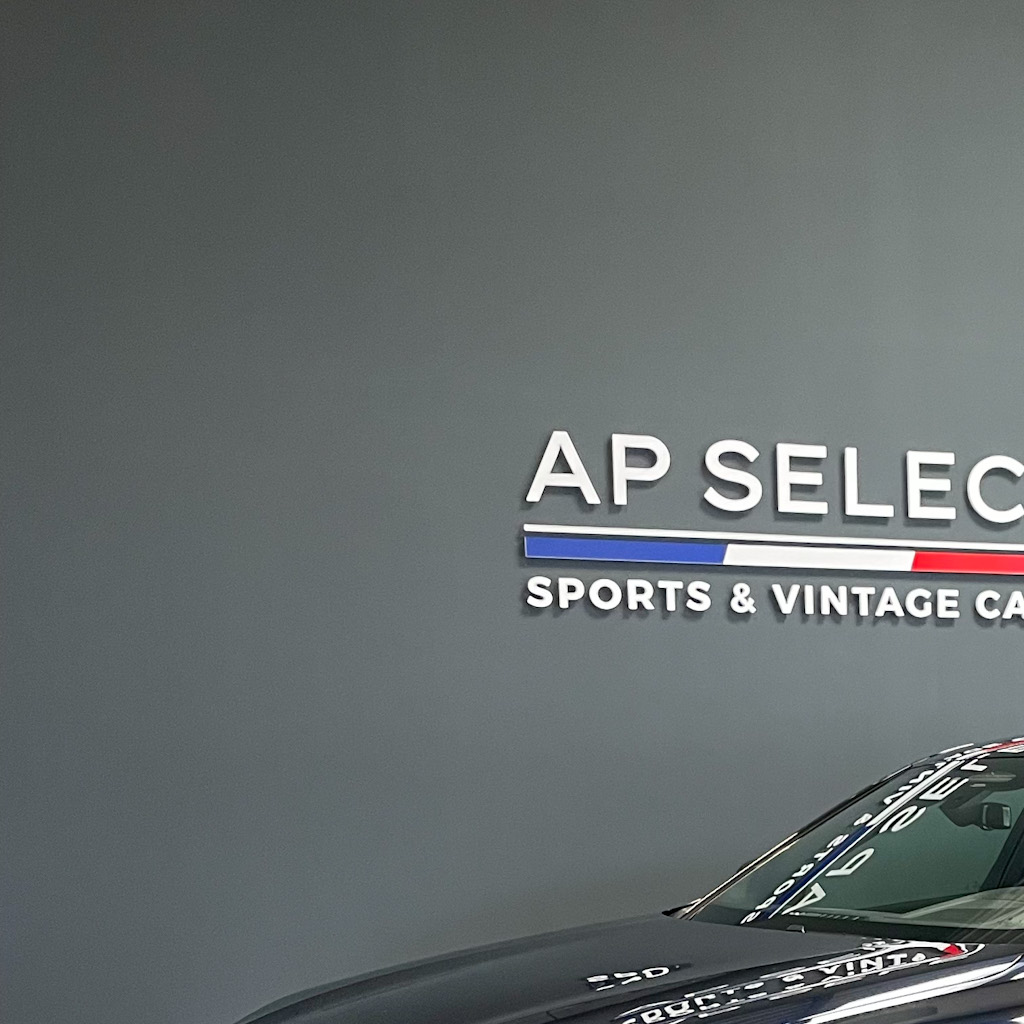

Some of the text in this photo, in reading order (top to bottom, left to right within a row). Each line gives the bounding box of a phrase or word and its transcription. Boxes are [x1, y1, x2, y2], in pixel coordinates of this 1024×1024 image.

[526, 430, 671, 505] AP
[526, 576, 712, 613] SPORTS
[730, 582, 757, 614] &
[771, 583, 960, 619] VINTAGE
